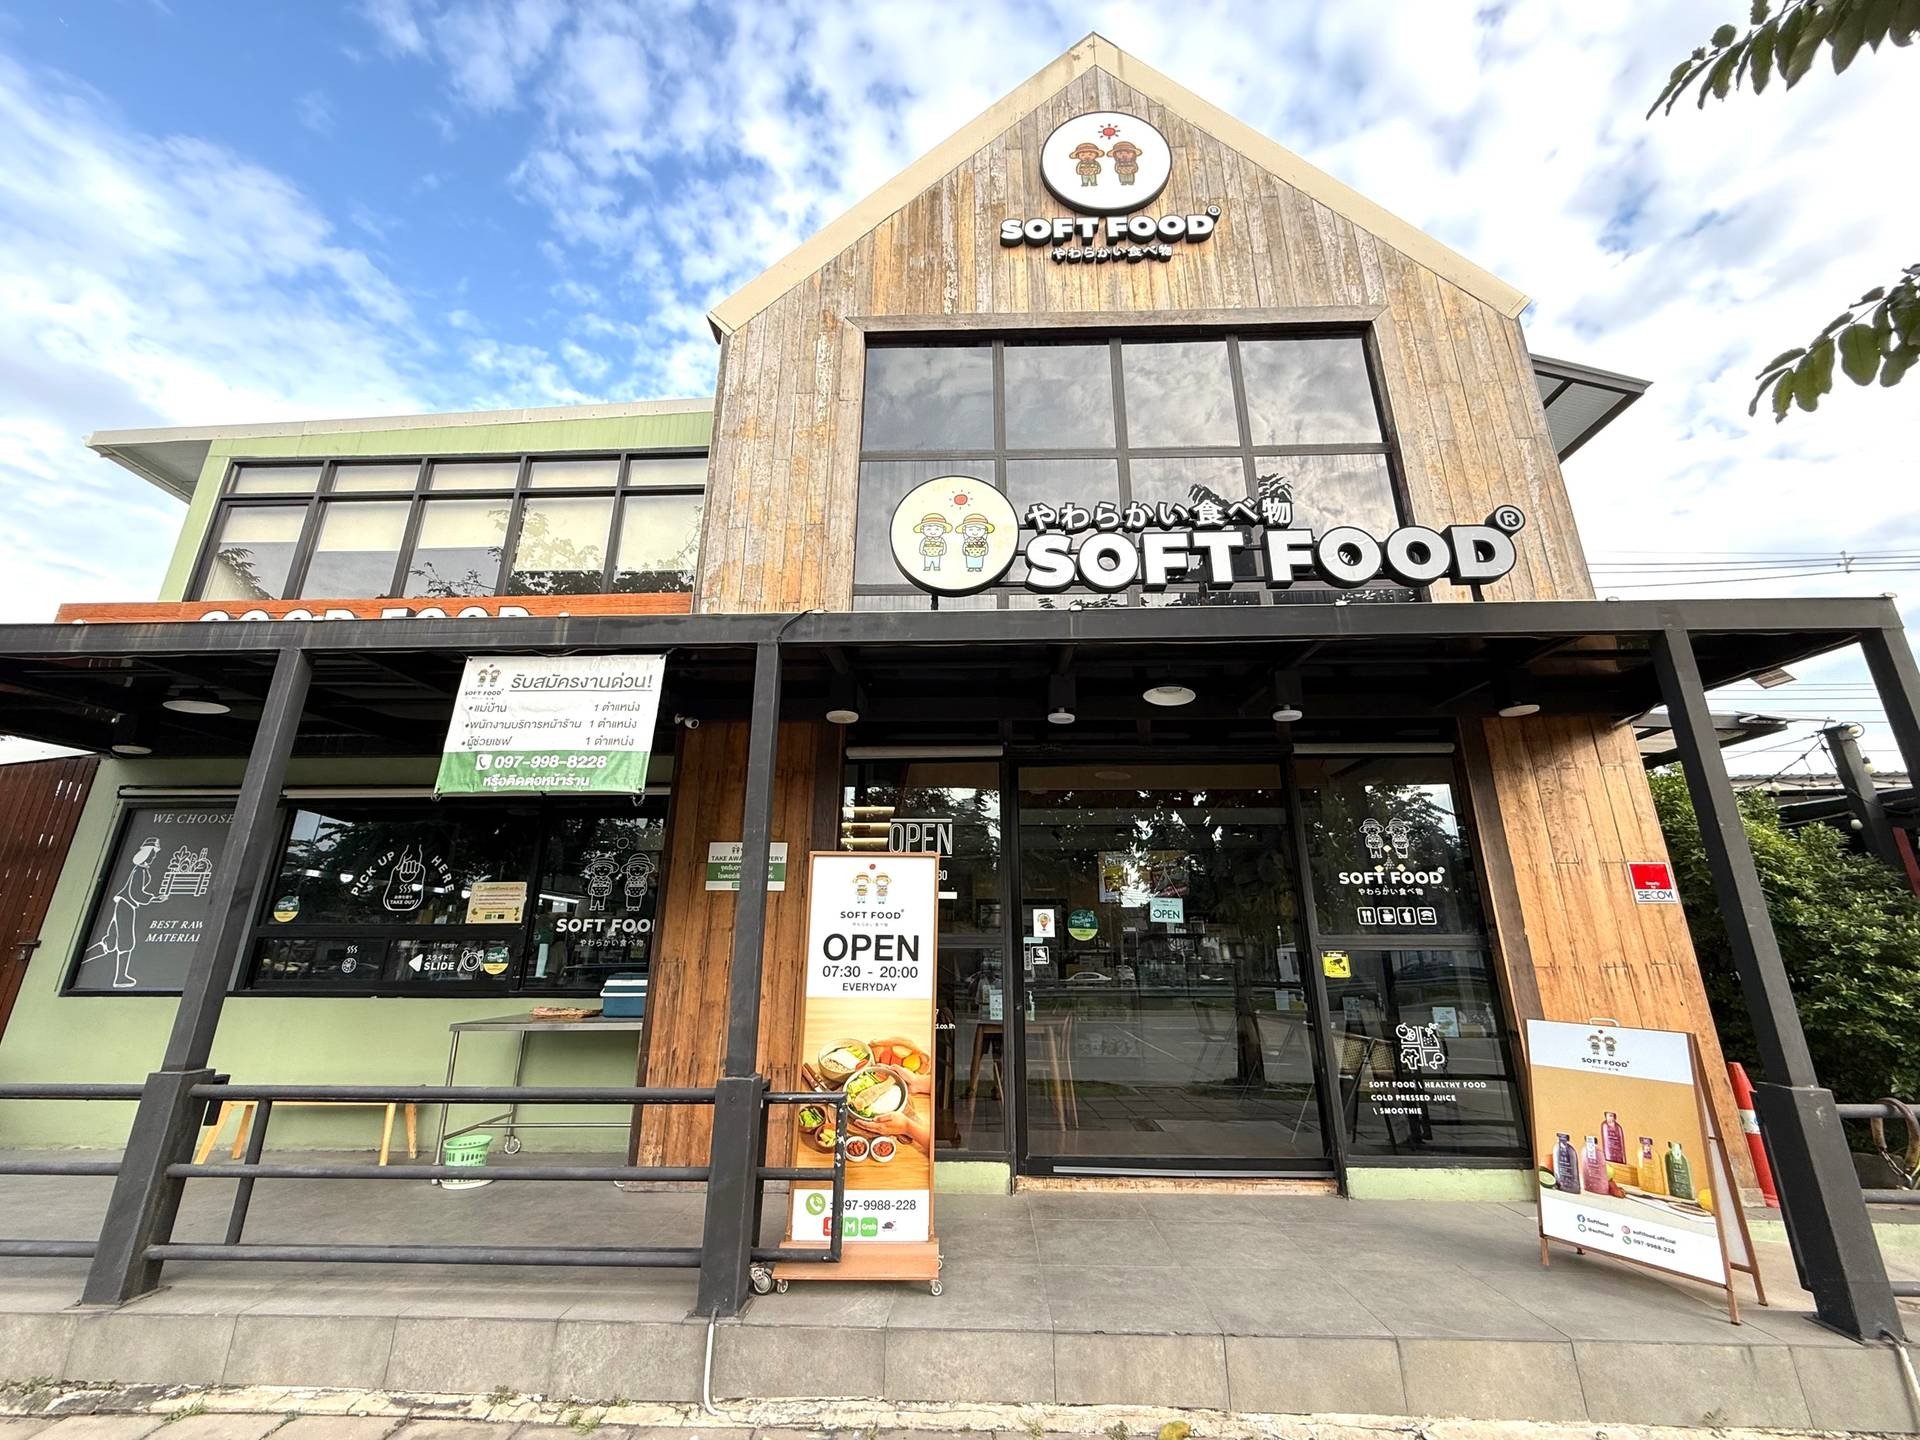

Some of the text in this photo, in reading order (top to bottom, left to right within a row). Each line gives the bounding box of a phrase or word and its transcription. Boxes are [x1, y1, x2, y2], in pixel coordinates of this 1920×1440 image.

[1000, 216, 1099, 243] SOFT
[1052, 246, 1172, 263] やわらかい食べ物
[1027, 498, 1293, 529] やわらかい食べ物
[1026, 531, 1244, 591] SOFT
[511, 672, 653, 690] รับสมัครงานด่วน!
[474, 702, 640, 713] แม่บ้าน 1 ตำแหน่ง
[589, 720, 594, 728] 1
[598, 718, 637, 729] ตำแหน่ง
[586, 737, 591, 745] 1
[594, 736, 634, 746] ตำแหน่ง
[494, 754, 608, 769] 097-998-8228
[483, 773, 590, 787] หรือติดต่อหน้าร้าน
[153, 813, 235, 824] WE CHOOSE
[888, 823, 953, 855] OPEN
[351, 851, 455, 896] PICK UP HERE
[1338, 871, 1385, 885] SOFT
[1358, 887, 1424, 896] やわらかい食べ物
[1637, 890, 1674, 900] SECOM
[840, 911, 867, 919] SOFT
[1153, 909, 1180, 919] OPEN
[149, 920, 178, 929] BEST
[555, 918, 606, 933] SOFT
[580, 938, 644, 947] やわらかい食べ物
[823, 933, 919, 962] OPEN
[424, 961, 456, 971] SLIDE
[822, 965, 861, 978] 07:30
[880, 966, 918, 978] 20:00
[842, 982, 898, 991] EVERYDAY
[1581, 1057, 1601, 1065] SOFT
[1432, 1094, 1457, 1102] JUICE
[1380, 1107, 1423, 1115] SMOOTHIE
